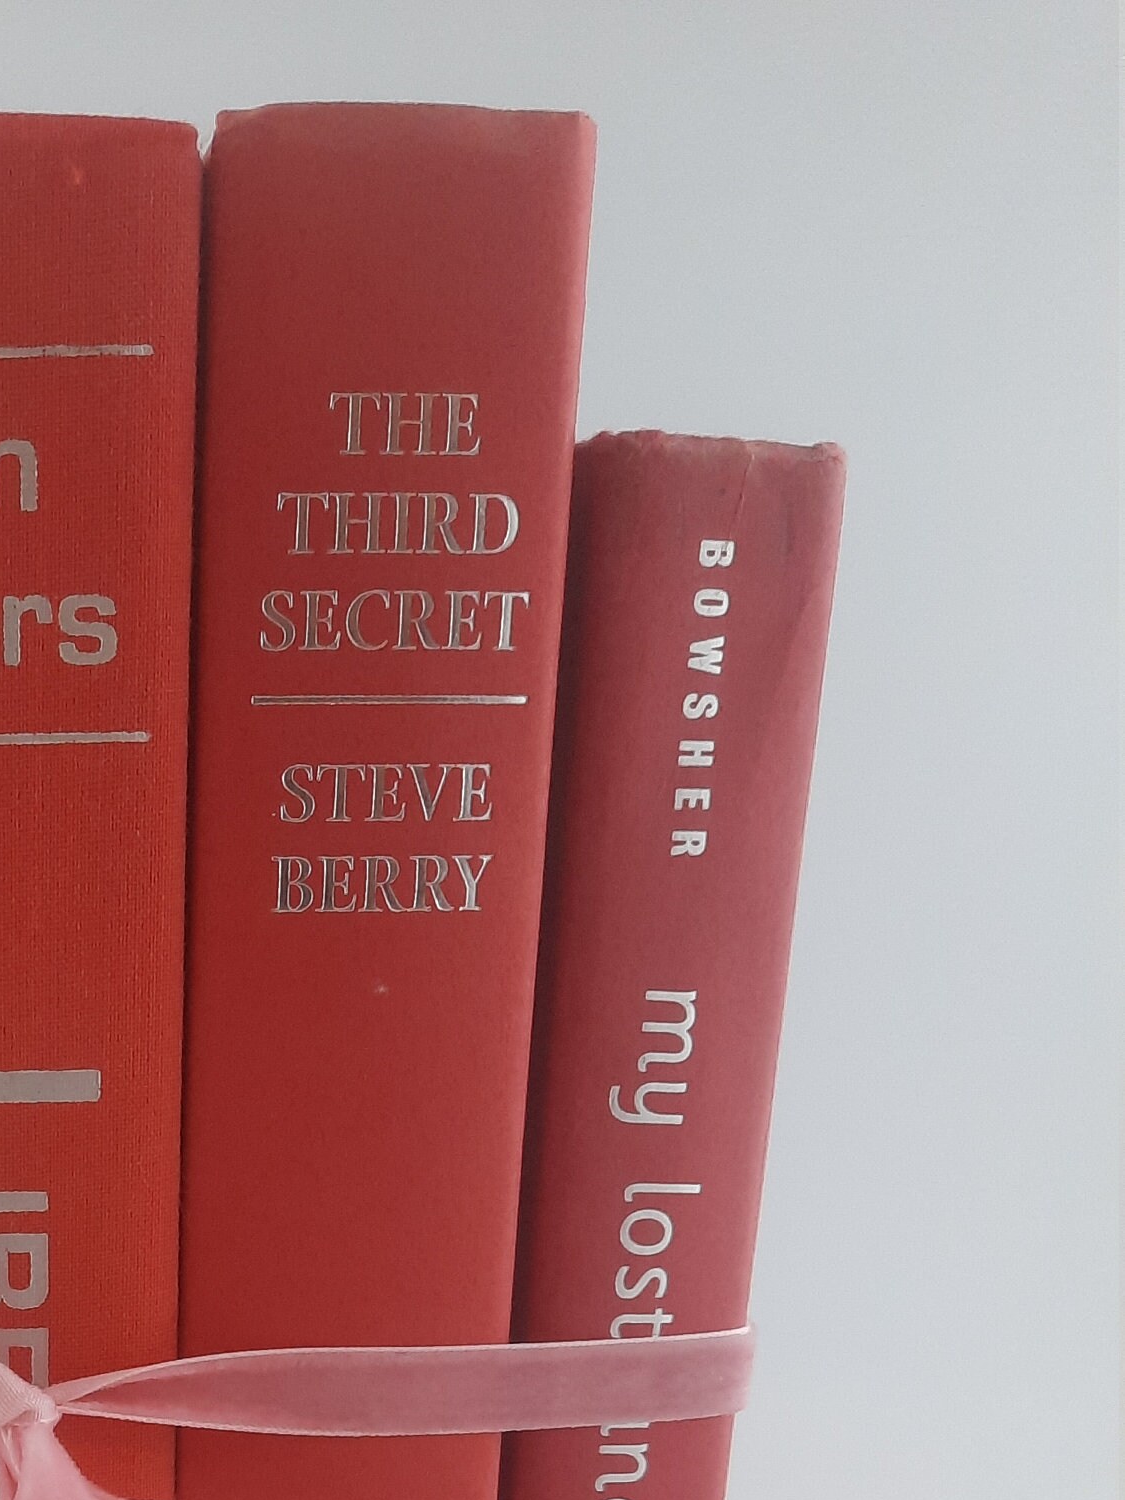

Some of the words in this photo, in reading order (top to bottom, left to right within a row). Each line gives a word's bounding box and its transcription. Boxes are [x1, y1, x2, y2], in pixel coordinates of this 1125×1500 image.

[329, 392, 481, 456] THE
[277, 492, 520, 554] THIRD
[259, 590, 529, 652] SECRET
[671, 538, 734, 857] BOWSHER
[280, 763, 493, 823] STEVE
[271, 854, 494, 913] BERRY
[608, 990, 697, 1126] my
[610, 1183, 702, 1338] lost
